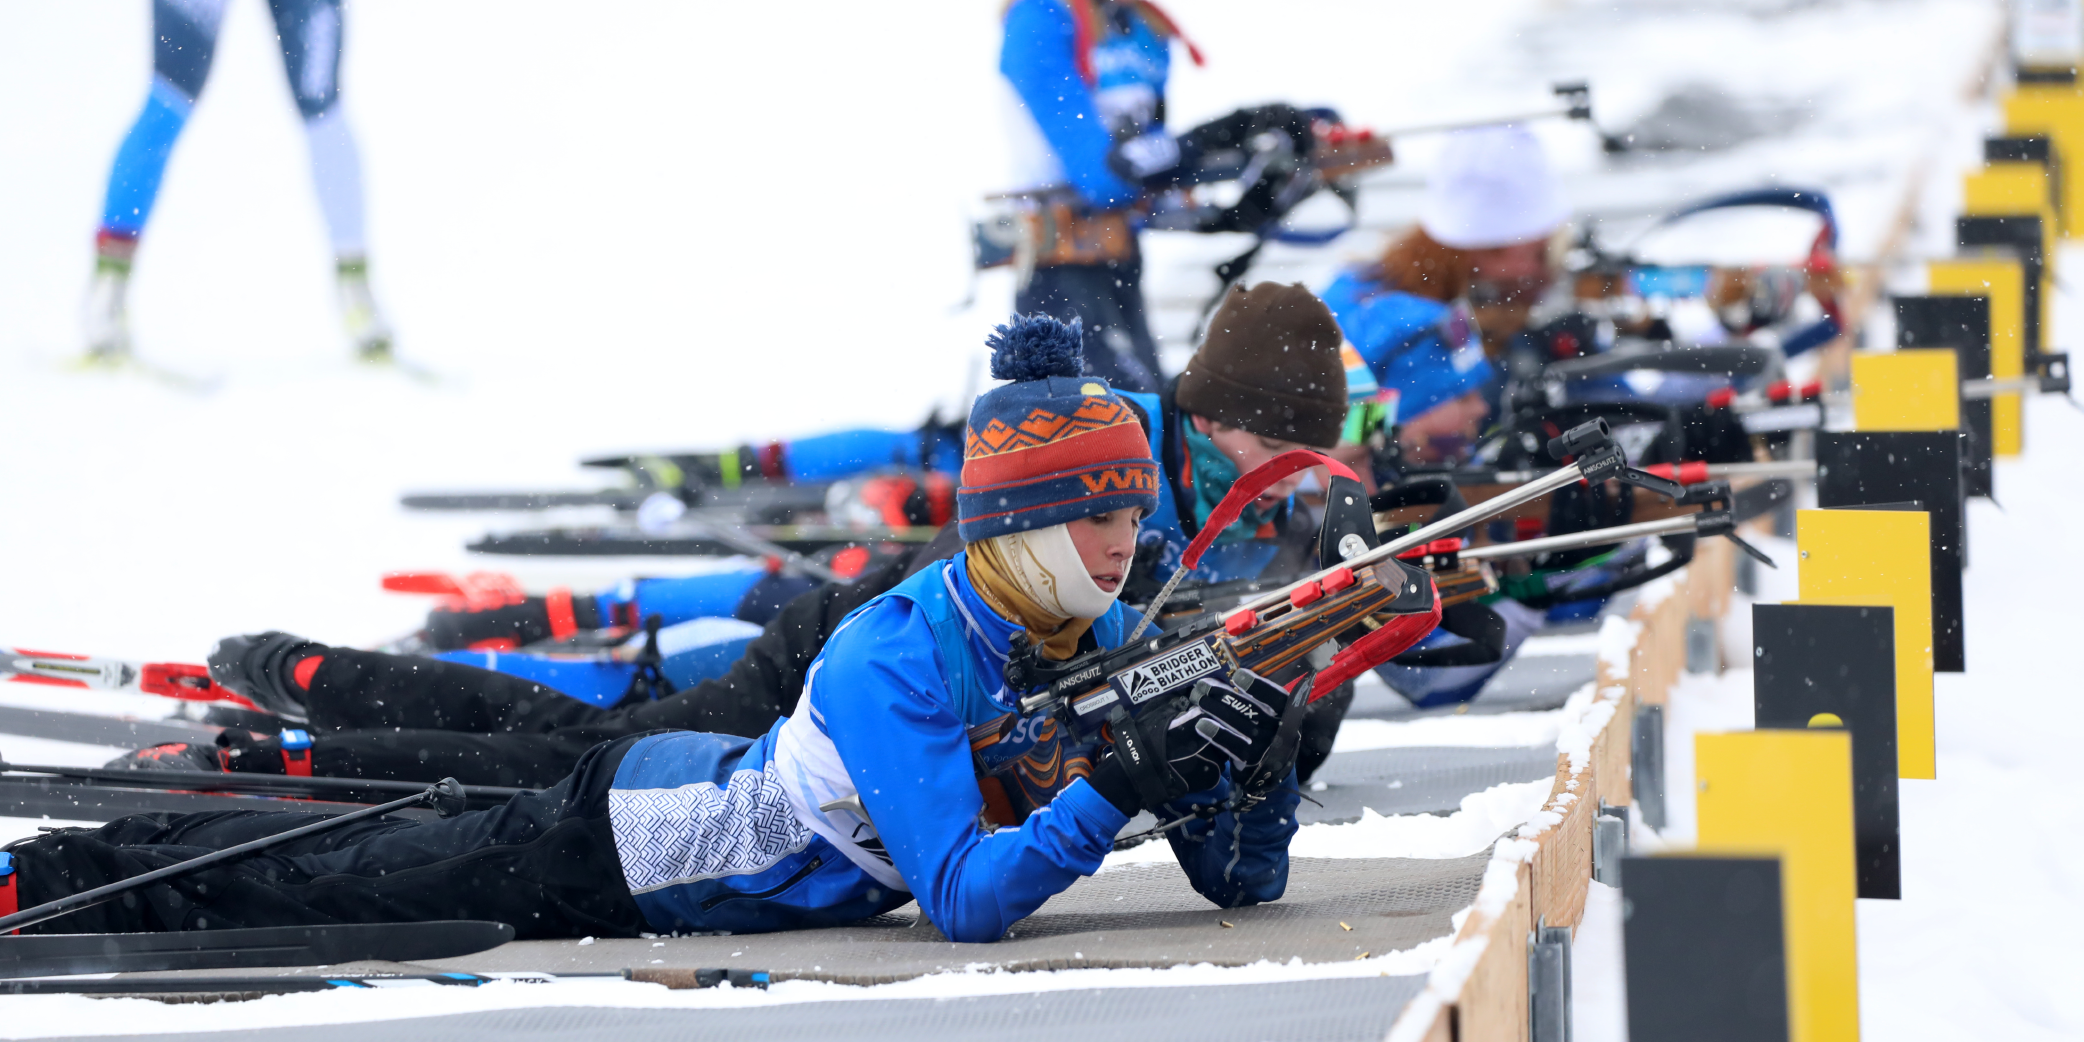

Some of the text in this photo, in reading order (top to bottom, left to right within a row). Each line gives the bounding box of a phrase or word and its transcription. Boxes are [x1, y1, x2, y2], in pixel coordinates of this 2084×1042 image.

[1150, 648, 1204, 677] BRIDGER
[1156, 655, 1217, 687] BIATHLON
[1059, 666, 1101, 691] ANSCHUTZ
